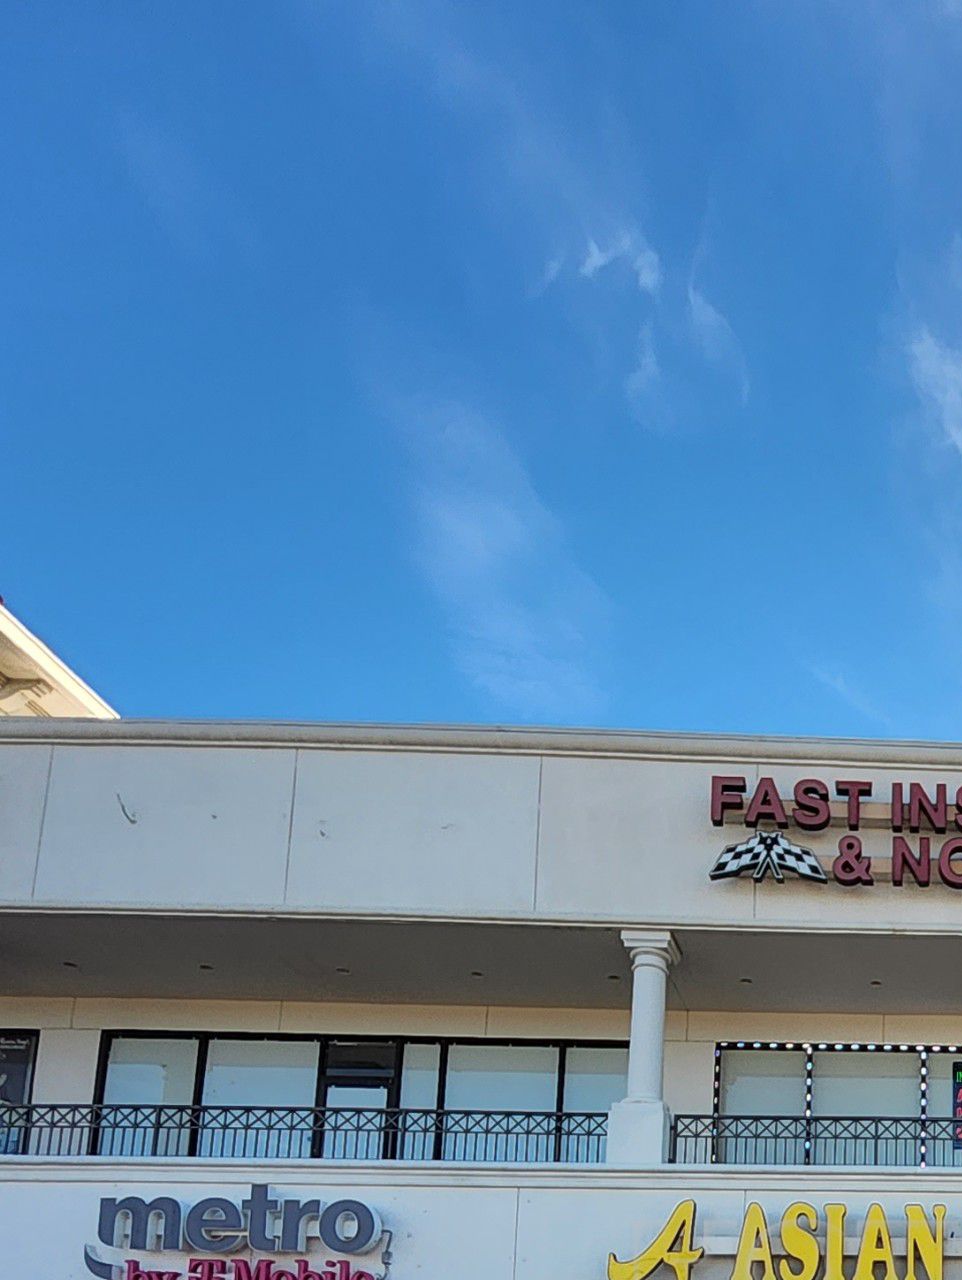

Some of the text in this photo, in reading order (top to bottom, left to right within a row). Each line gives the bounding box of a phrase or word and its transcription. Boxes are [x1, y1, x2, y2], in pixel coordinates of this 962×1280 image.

[710, 775, 872, 830] FAST
[832, 836, 875, 887] &
[97, 1184, 378, 1253] metro
